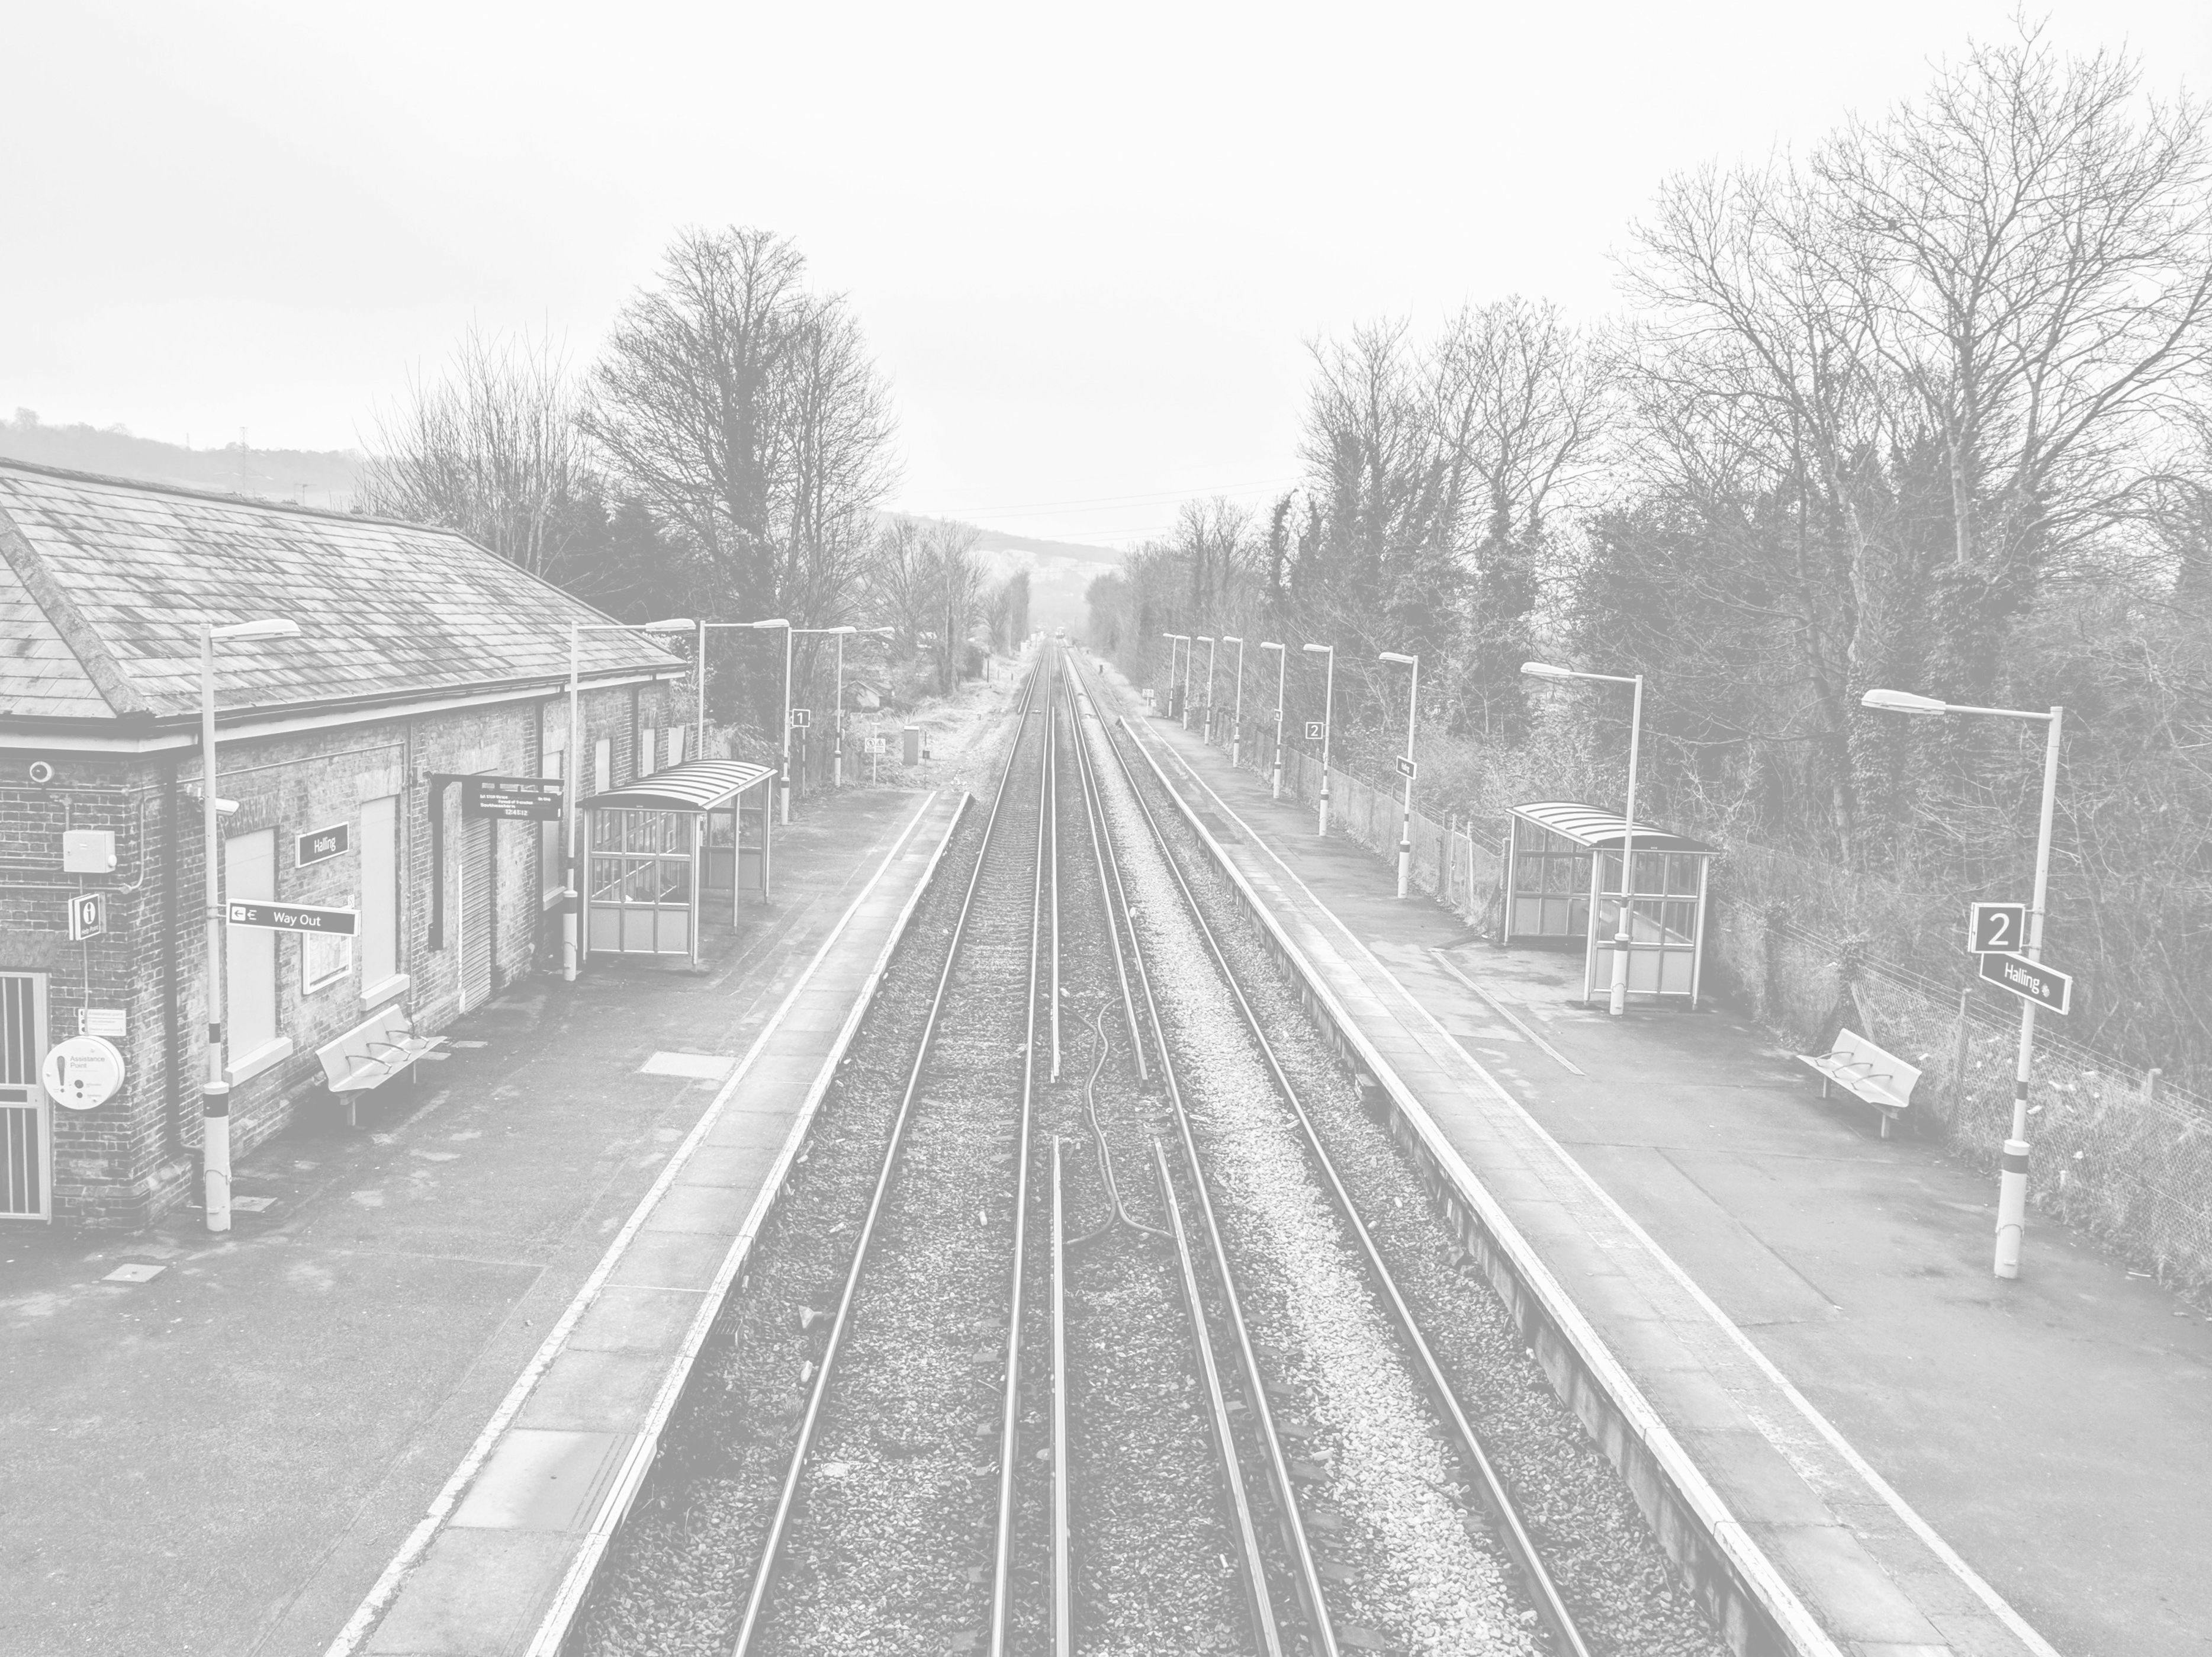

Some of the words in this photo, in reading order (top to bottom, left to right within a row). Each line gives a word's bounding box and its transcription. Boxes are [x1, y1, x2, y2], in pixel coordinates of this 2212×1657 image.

[797, 712, 803, 724] 1
[1311, 725, 1319, 736] 2
[314, 837, 336, 853] Halling
[274, 911, 297, 927] Way
[300, 914, 321, 926] Out
[1988, 913, 2010, 945] 2
[2004, 962, 2040, 994] Halling
